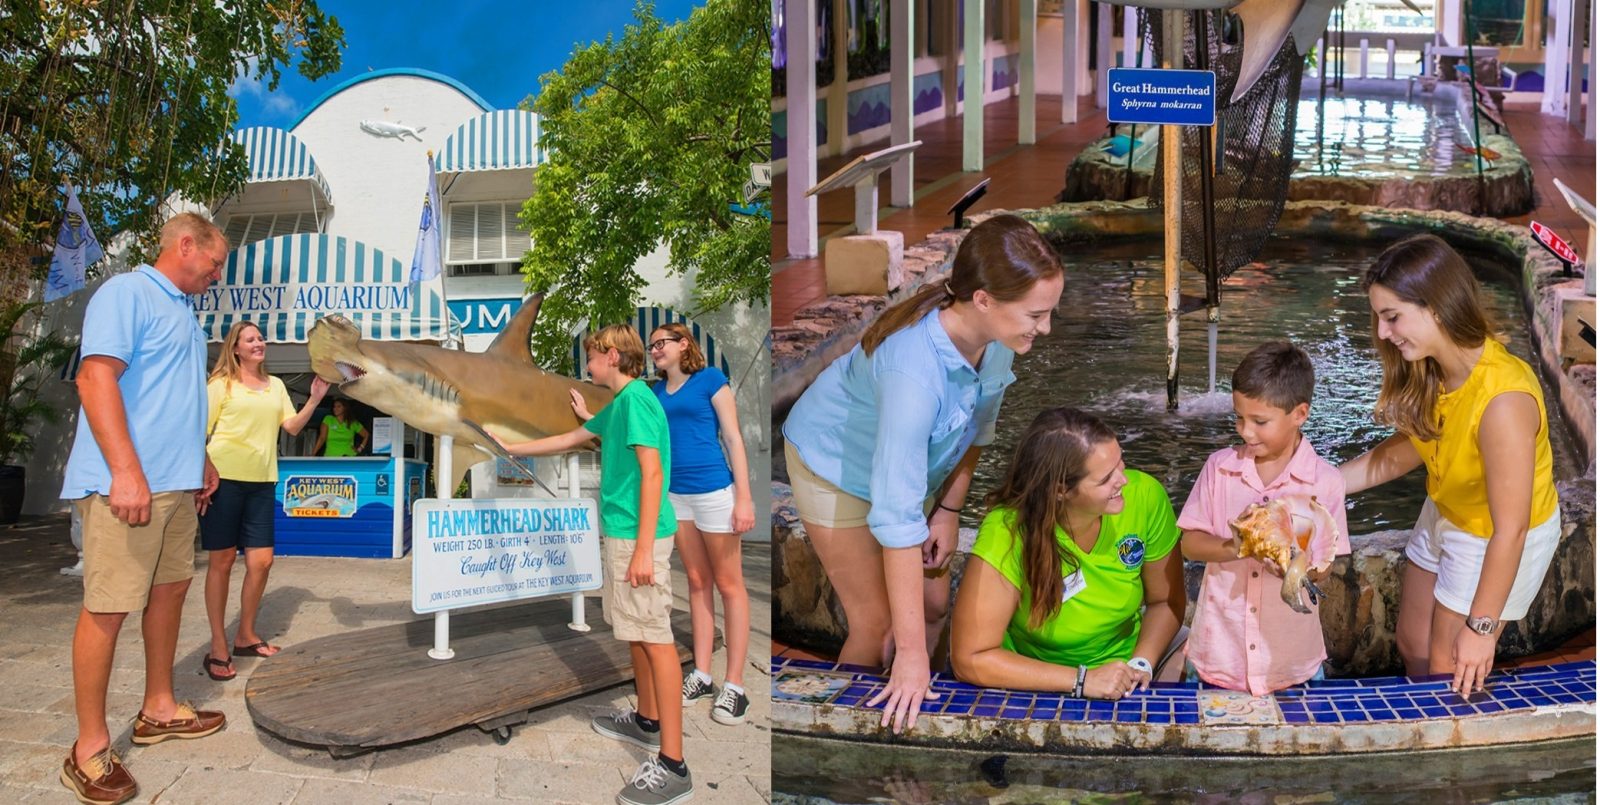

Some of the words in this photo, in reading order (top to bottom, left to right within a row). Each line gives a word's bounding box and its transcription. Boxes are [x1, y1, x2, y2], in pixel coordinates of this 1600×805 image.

[1112, 82, 1140, 93] Great
[1142, 83, 1210, 96] Hammerhead
[1121, 98, 1157, 110] Sphyrna
[1160, 100, 1203, 110] mokarran
[229, 286, 286, 311] WEST
[294, 285, 409, 311] AQUARIUM
[287, 483, 354, 501] AQUARIUM
[428, 509, 542, 538] HAMMERHEAD
[543, 507, 591, 532] SHARK
[433, 541, 464, 553] WEIGHT
[467, 539, 483, 551] 250
[500, 537, 522, 548] GIRTH
[461, 554, 498, 578] Caught
[500, 552, 518, 573] Off
[520, 551, 543, 572] Key
[544, 549, 567, 566] West
[429, 592, 443, 602] JOIN
[527, 578, 537, 589] THE
[538, 576, 549, 588] KEY
[549, 575, 565, 586] WEST
[566, 573, 593, 586] AQUARIUM
